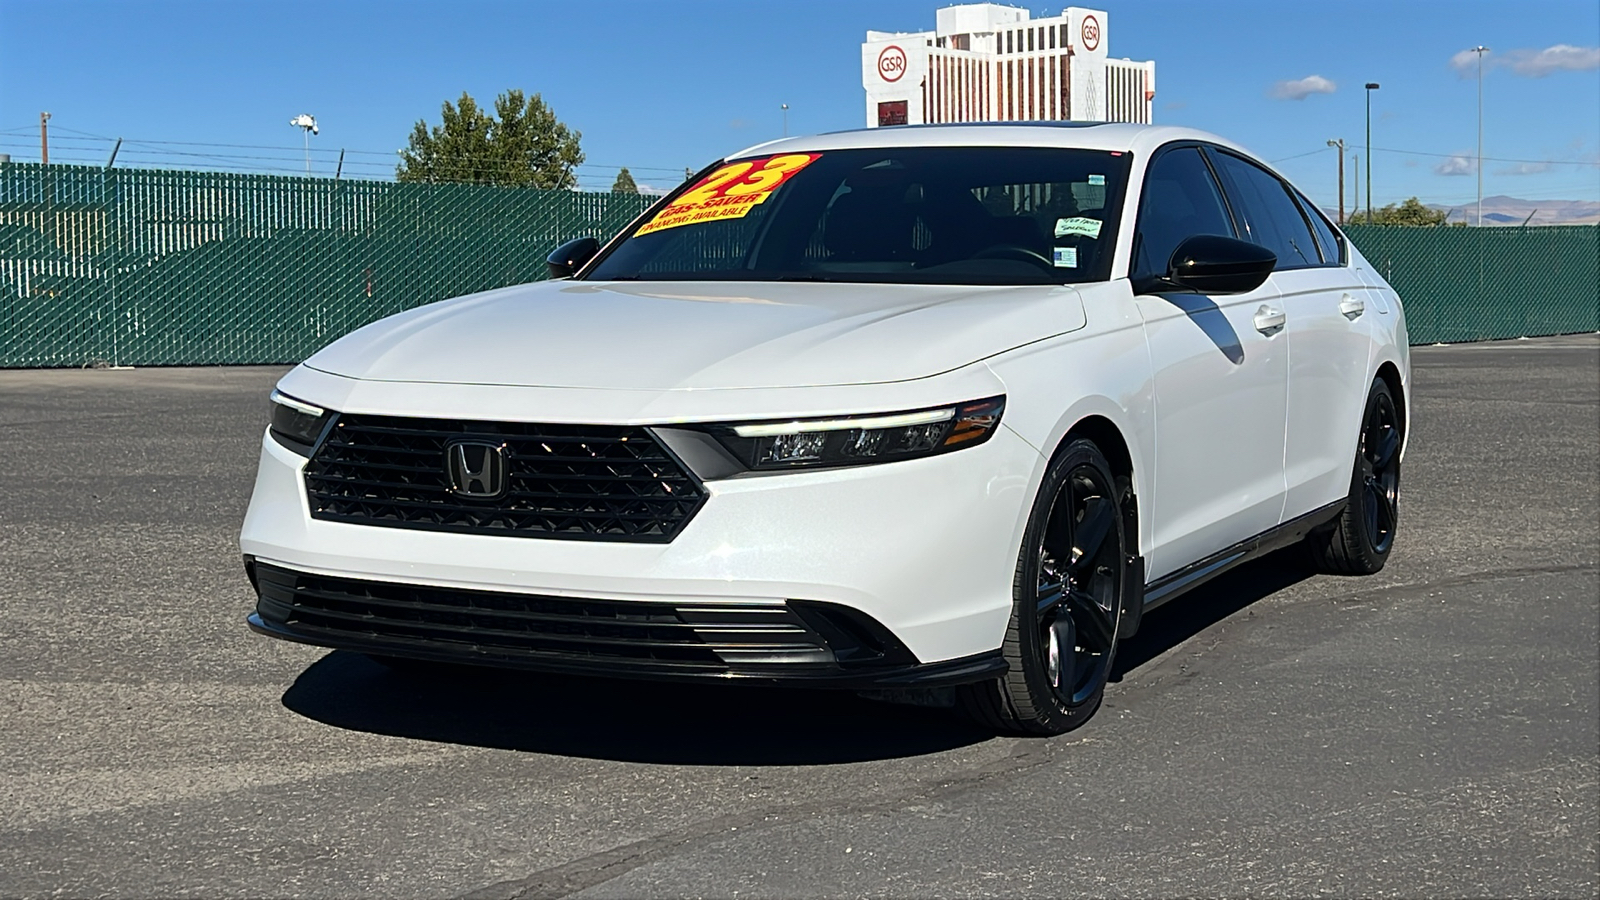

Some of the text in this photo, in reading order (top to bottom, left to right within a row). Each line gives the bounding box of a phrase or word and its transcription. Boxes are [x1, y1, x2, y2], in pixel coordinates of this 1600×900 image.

[1084, 25, 1098, 41] GSR
[881, 55, 902, 72] GSR
[672, 154, 811, 206] 23
[659, 193, 762, 219] GAS-SAVER
[692, 206, 748, 221] AVAILABLE
